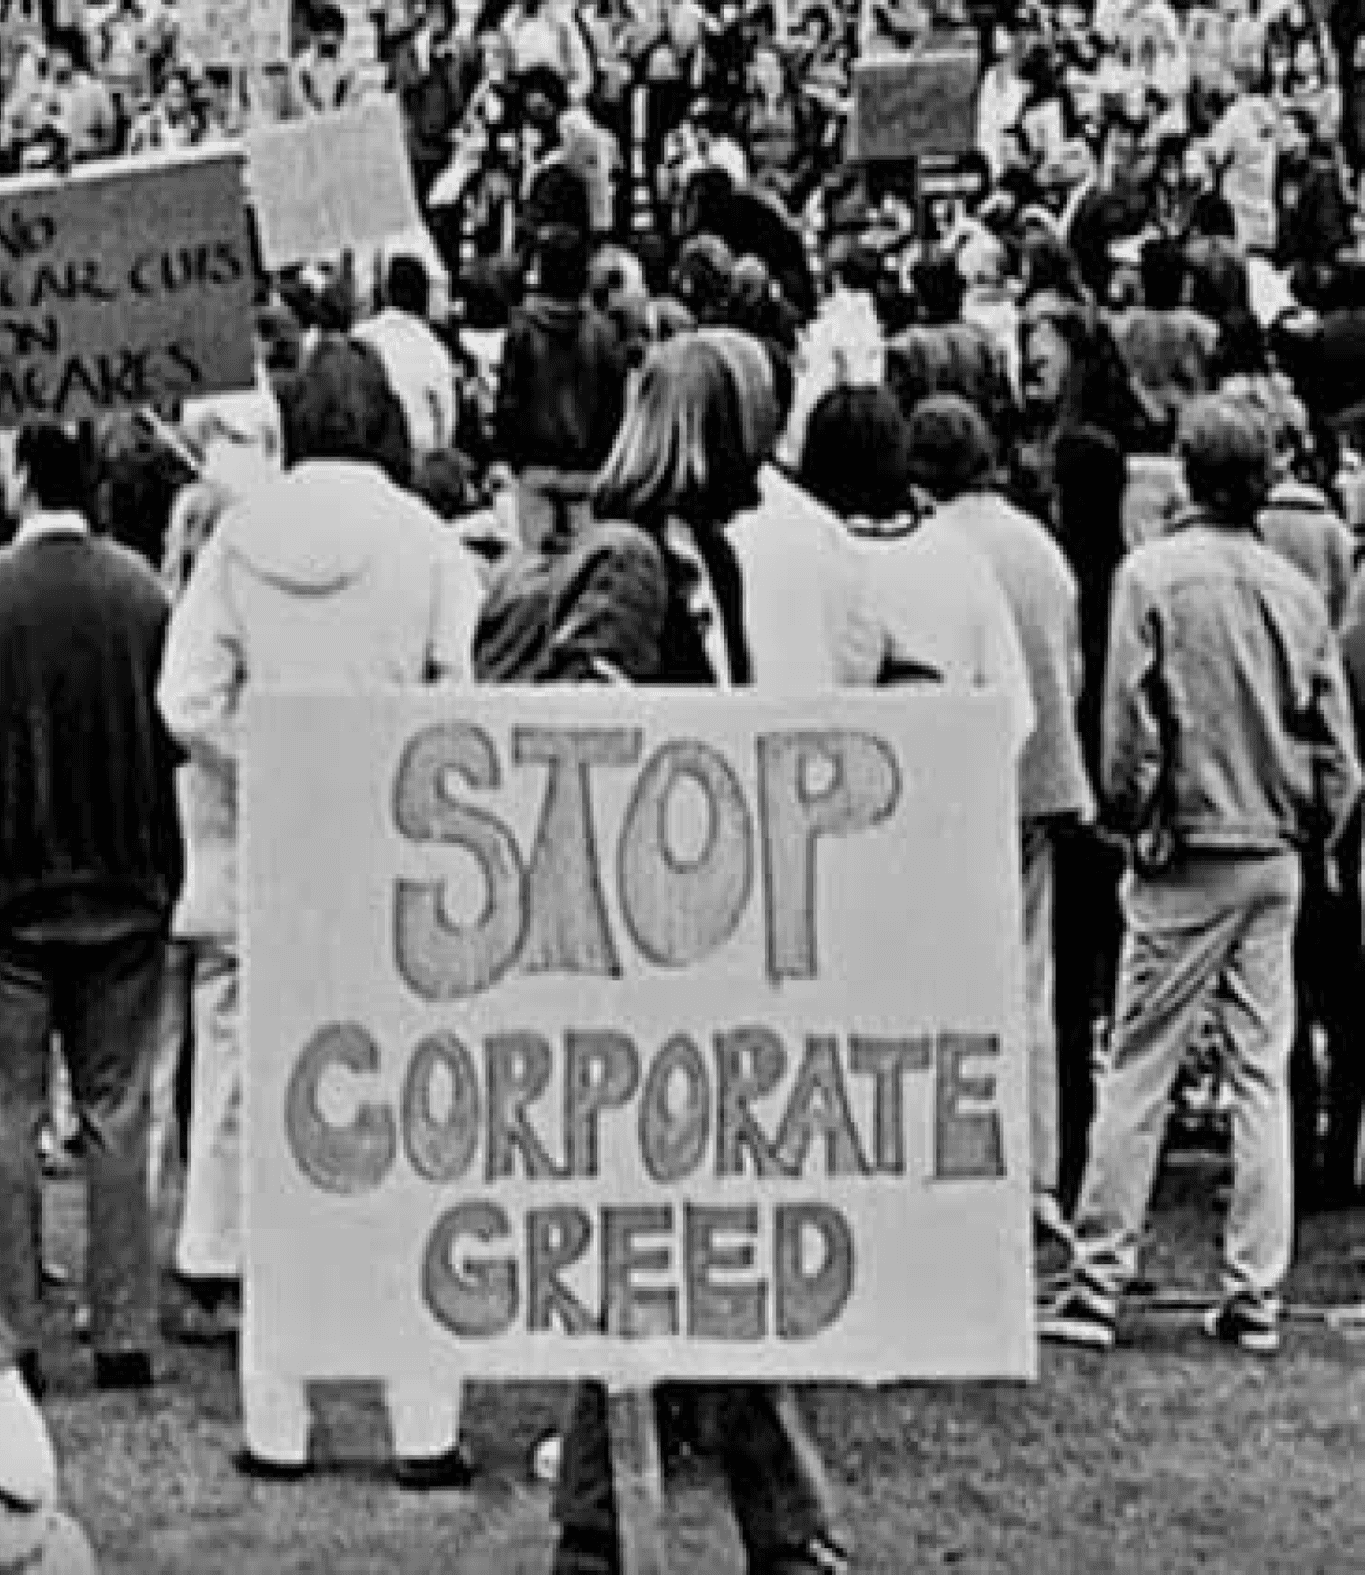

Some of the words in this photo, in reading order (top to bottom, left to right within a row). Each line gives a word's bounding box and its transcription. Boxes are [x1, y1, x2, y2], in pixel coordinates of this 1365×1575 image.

[128, 238, 243, 295] CUTS
[390, 720, 903, 1002] STOP
[283, 1019, 1007, 1195] CORPORATE
[419, 1197, 855, 1340] GREED
